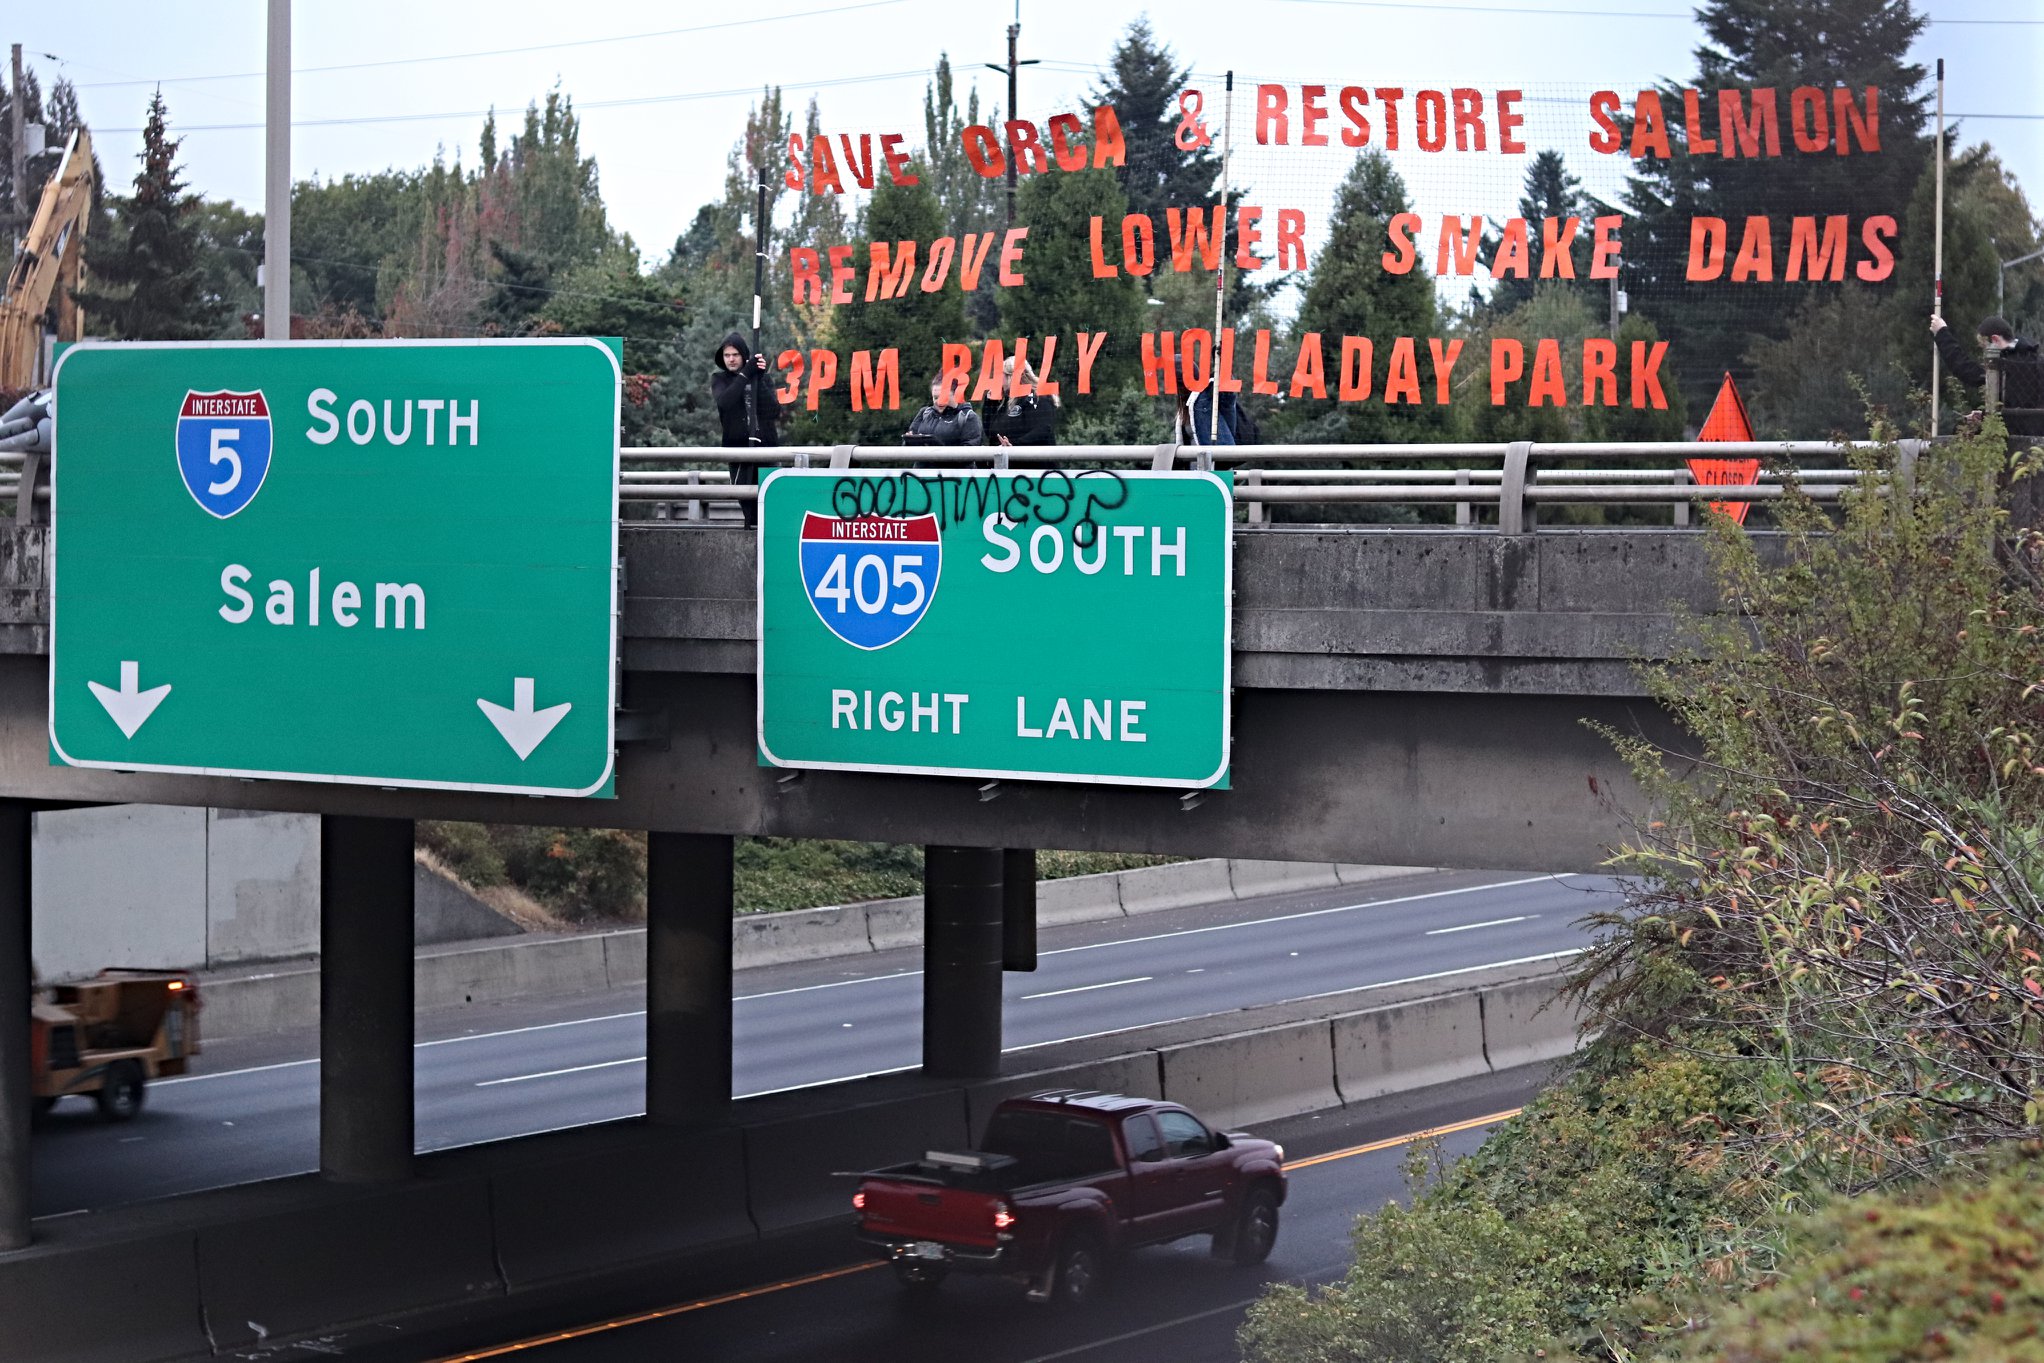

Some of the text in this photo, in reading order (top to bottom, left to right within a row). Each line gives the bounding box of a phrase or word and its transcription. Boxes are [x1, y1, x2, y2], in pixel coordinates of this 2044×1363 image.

[785, 84, 1881, 195] SAVE ORCA & RESTORE SALMON
[790, 206, 1898, 305] REMOVE LOWER SNAKE DAMS
[776, 328, 1670, 412] 3PM RALLY HOLLADAY PARK
[191, 399, 257, 415] INTERSTATE
[305, 387, 479, 446] SOUTH
[207, 428, 242, 496] 5
[830, 521, 908, 540] INTERSTATE
[980, 512, 1187, 576] SOUTH
[218, 563, 427, 630] Salem
[814, 554, 926, 615] 405
[831, 689, 1147, 742] RIGHT LANE
